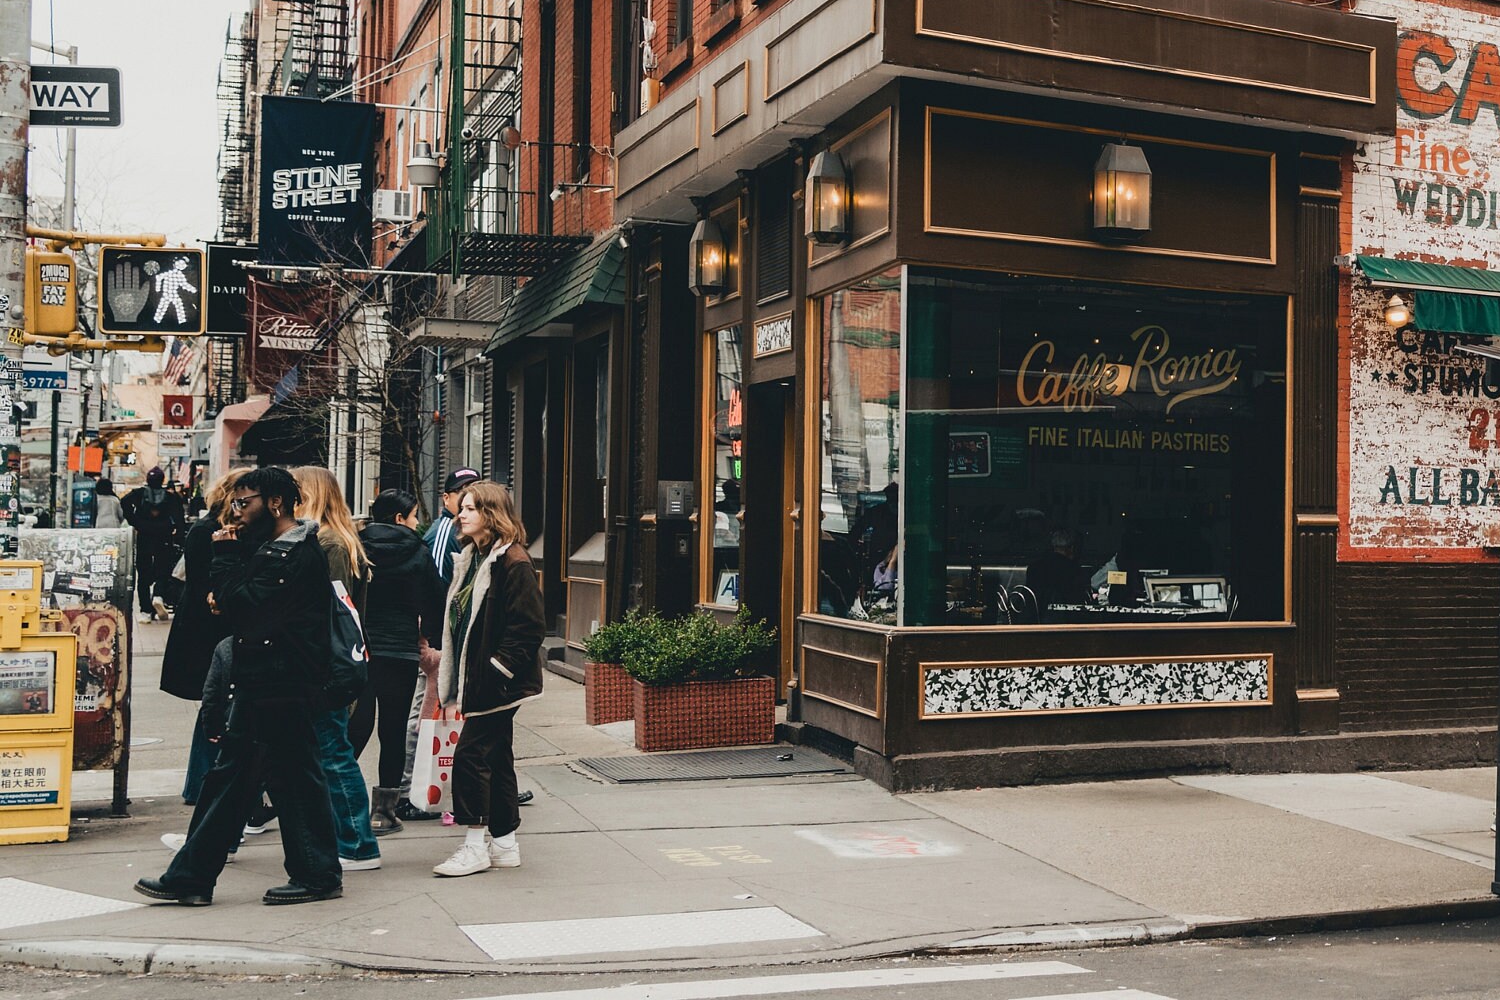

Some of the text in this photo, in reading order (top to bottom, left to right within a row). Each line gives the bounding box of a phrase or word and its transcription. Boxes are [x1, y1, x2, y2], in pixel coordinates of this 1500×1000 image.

[32, 84, 101, 108] WAY
[273, 163, 362, 191] STONE
[272, 184, 361, 209] STREET
[42, 294, 66, 305] JAY
[43, 285, 66, 296] FAT
[213, 285, 246, 294] DAPH
[259, 315, 327, 337] Ritual
[1129, 325, 1242, 415] Roma
[1028, 426, 1230, 453] FINE ITALIAN PASTRIES
[80, 490, 89, 503] P
[1379, 465, 1451, 506] ALL
[1, 778, 46, 788] 相大紀元
